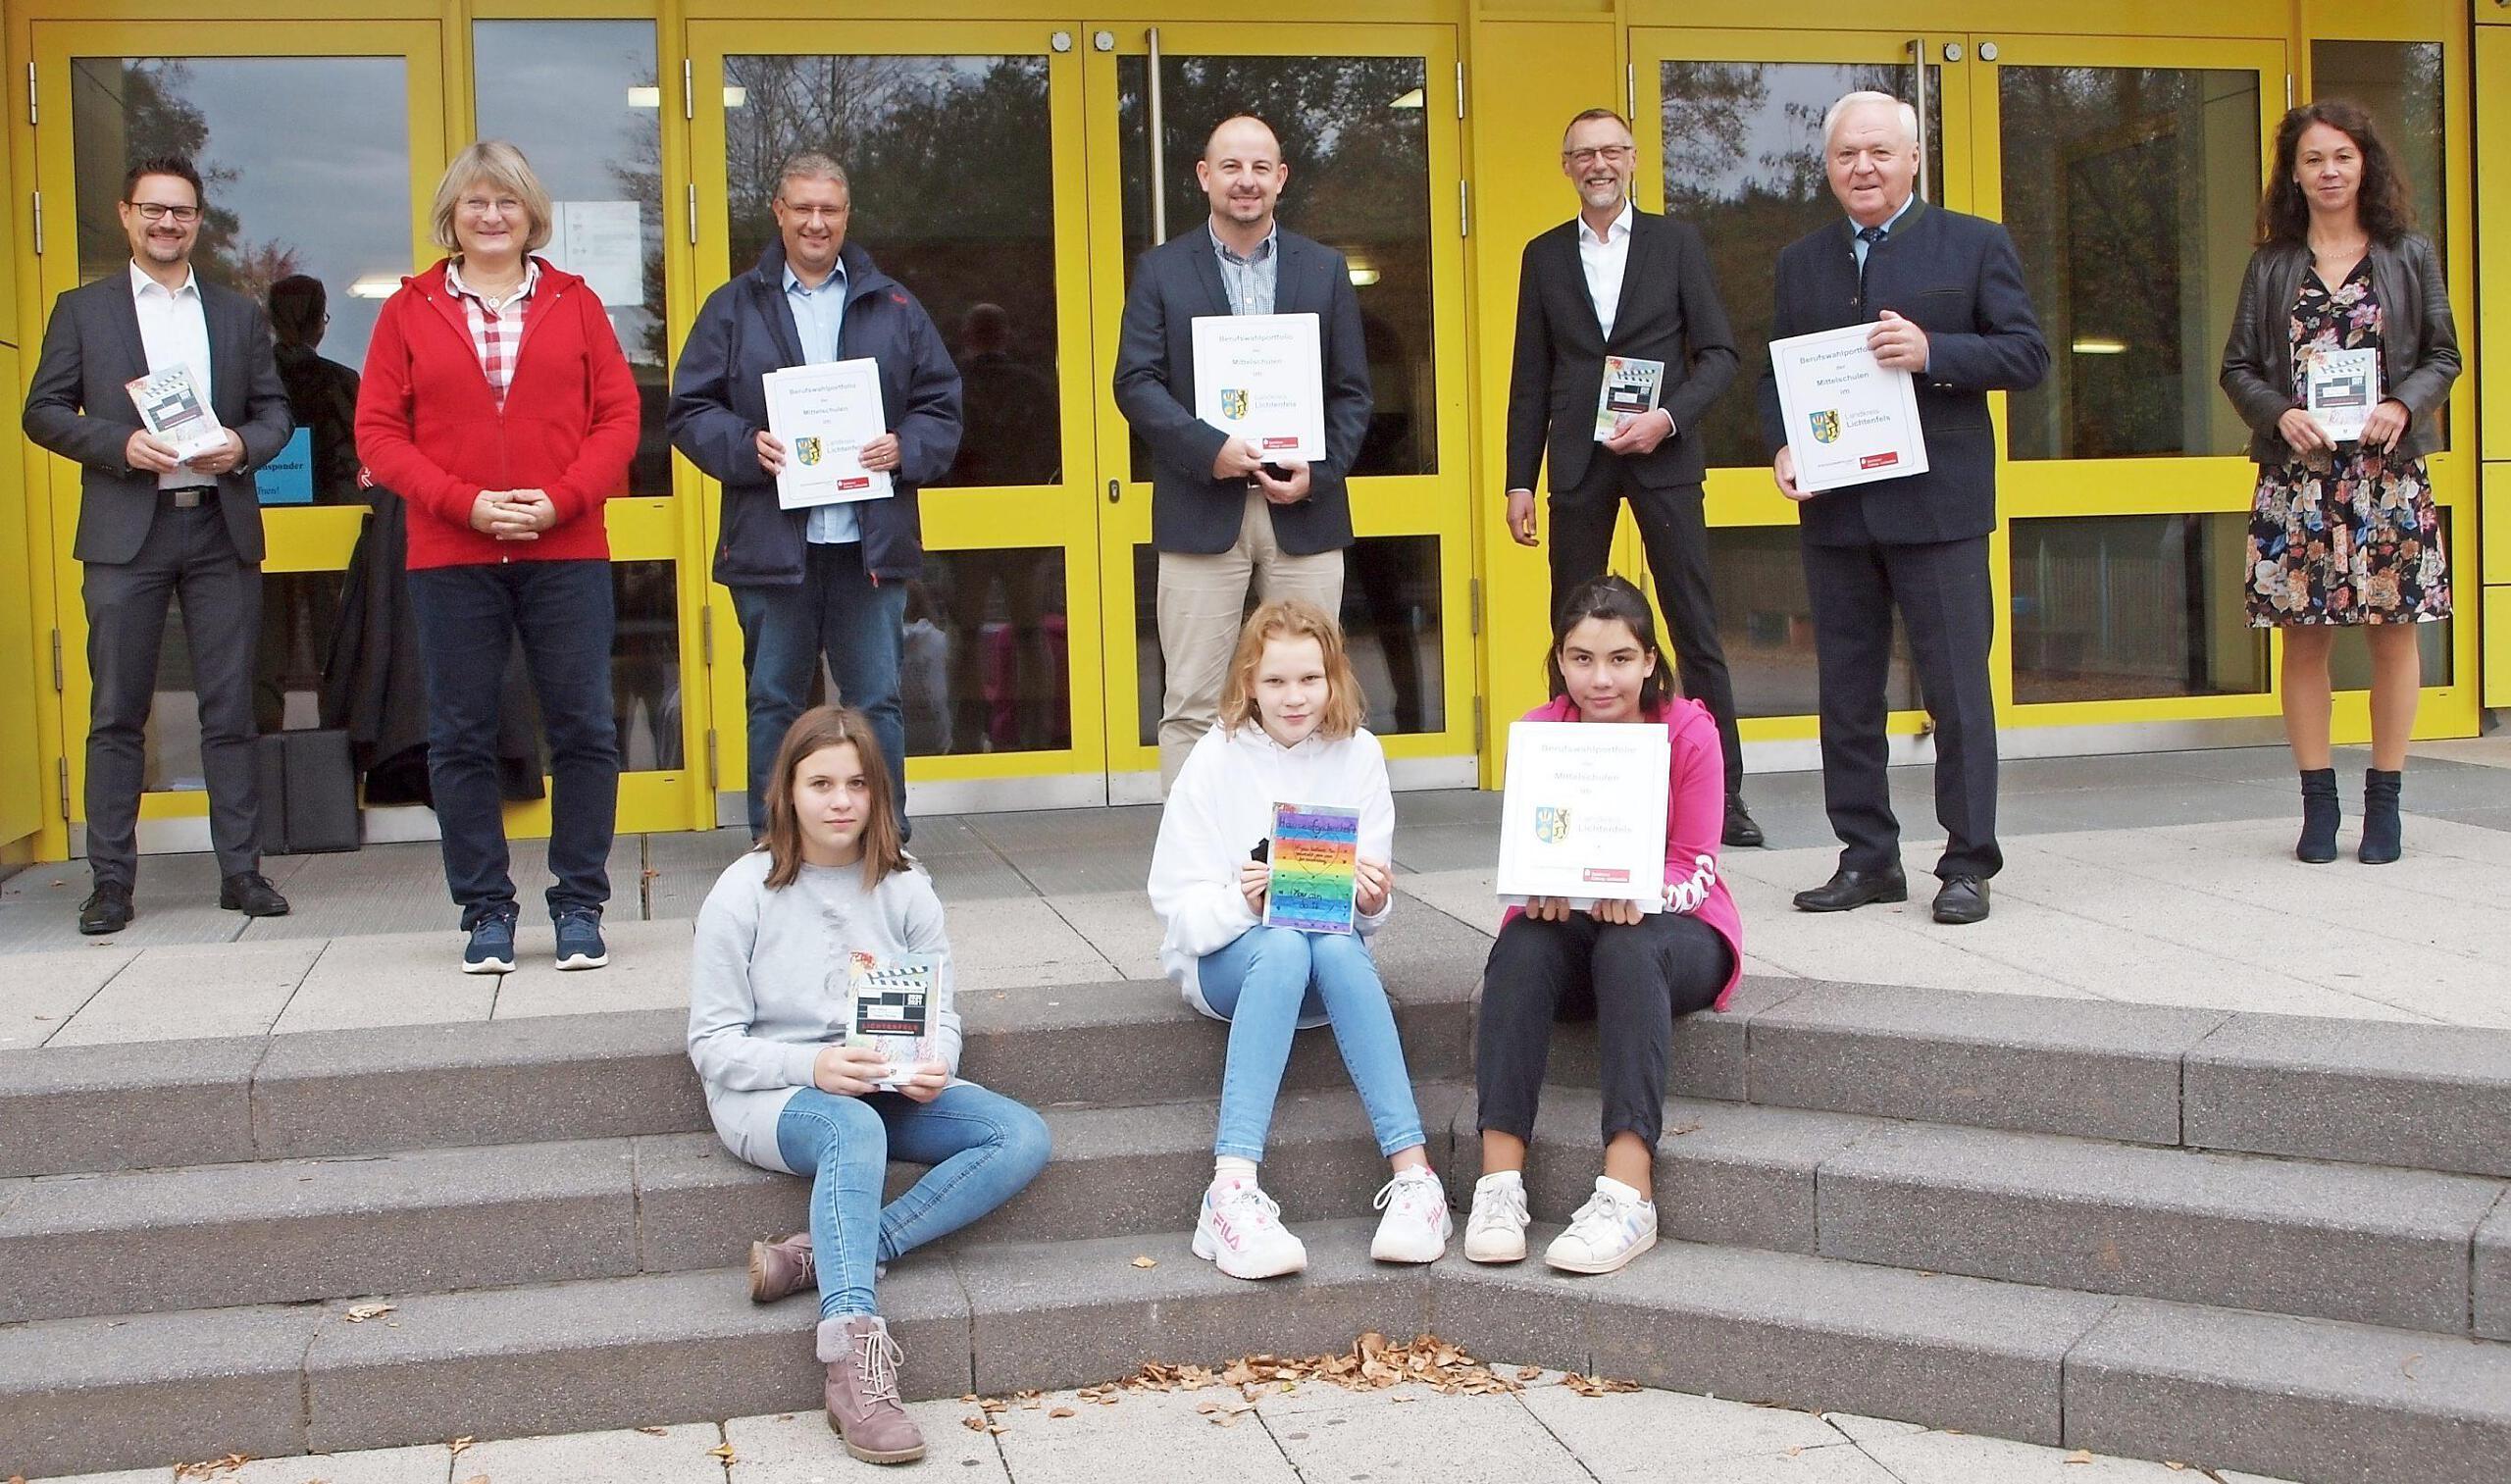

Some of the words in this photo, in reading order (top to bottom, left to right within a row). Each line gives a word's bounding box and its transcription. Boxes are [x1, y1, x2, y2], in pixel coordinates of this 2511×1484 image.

[1817, 371, 1870, 386] Mittelschulen
[1846, 415, 1891, 428] Lichtenfels
[1293, 888, 1307, 897] You
[1212, 1211, 1240, 1251] FILA
